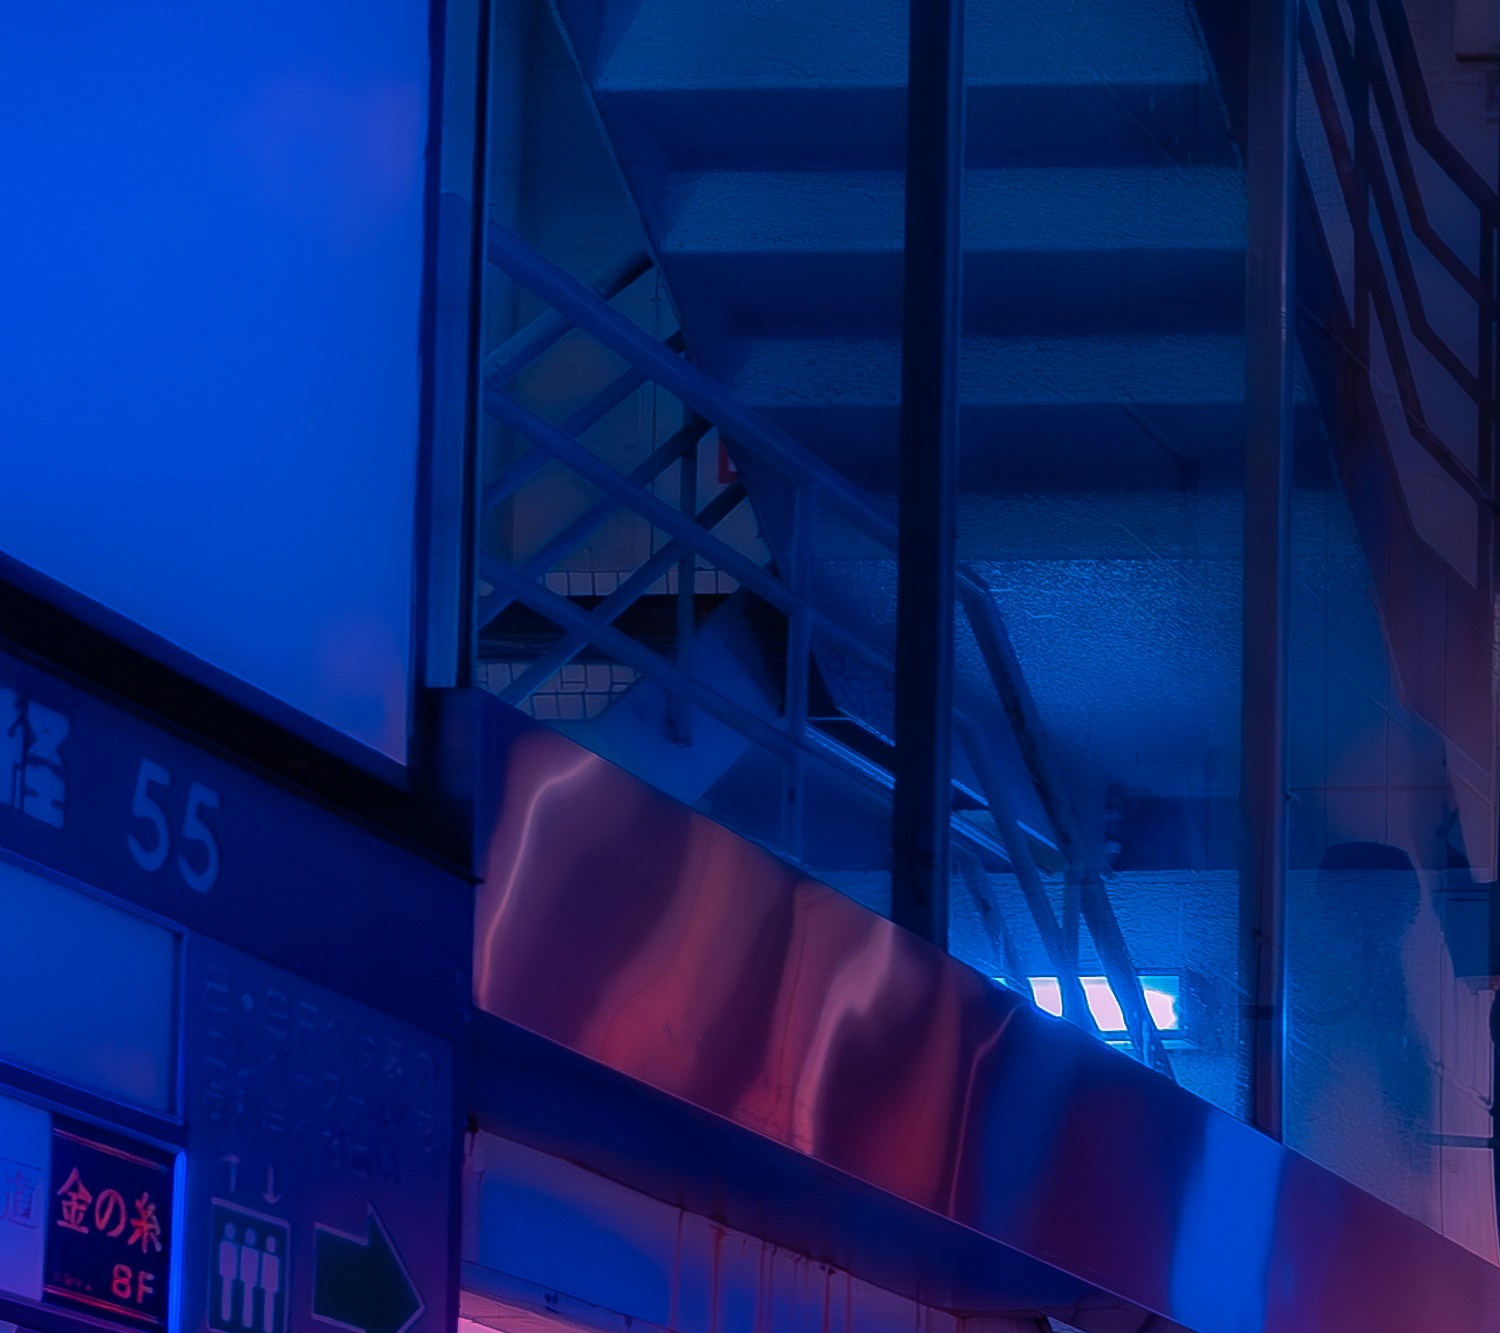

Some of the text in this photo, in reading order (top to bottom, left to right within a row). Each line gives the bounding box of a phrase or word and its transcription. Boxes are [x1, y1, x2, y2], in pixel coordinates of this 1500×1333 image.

[127, 757, 222, 893] 55
[56, 1165, 163, 1255] 金の糸
[110, 1263, 155, 1306] 8F
